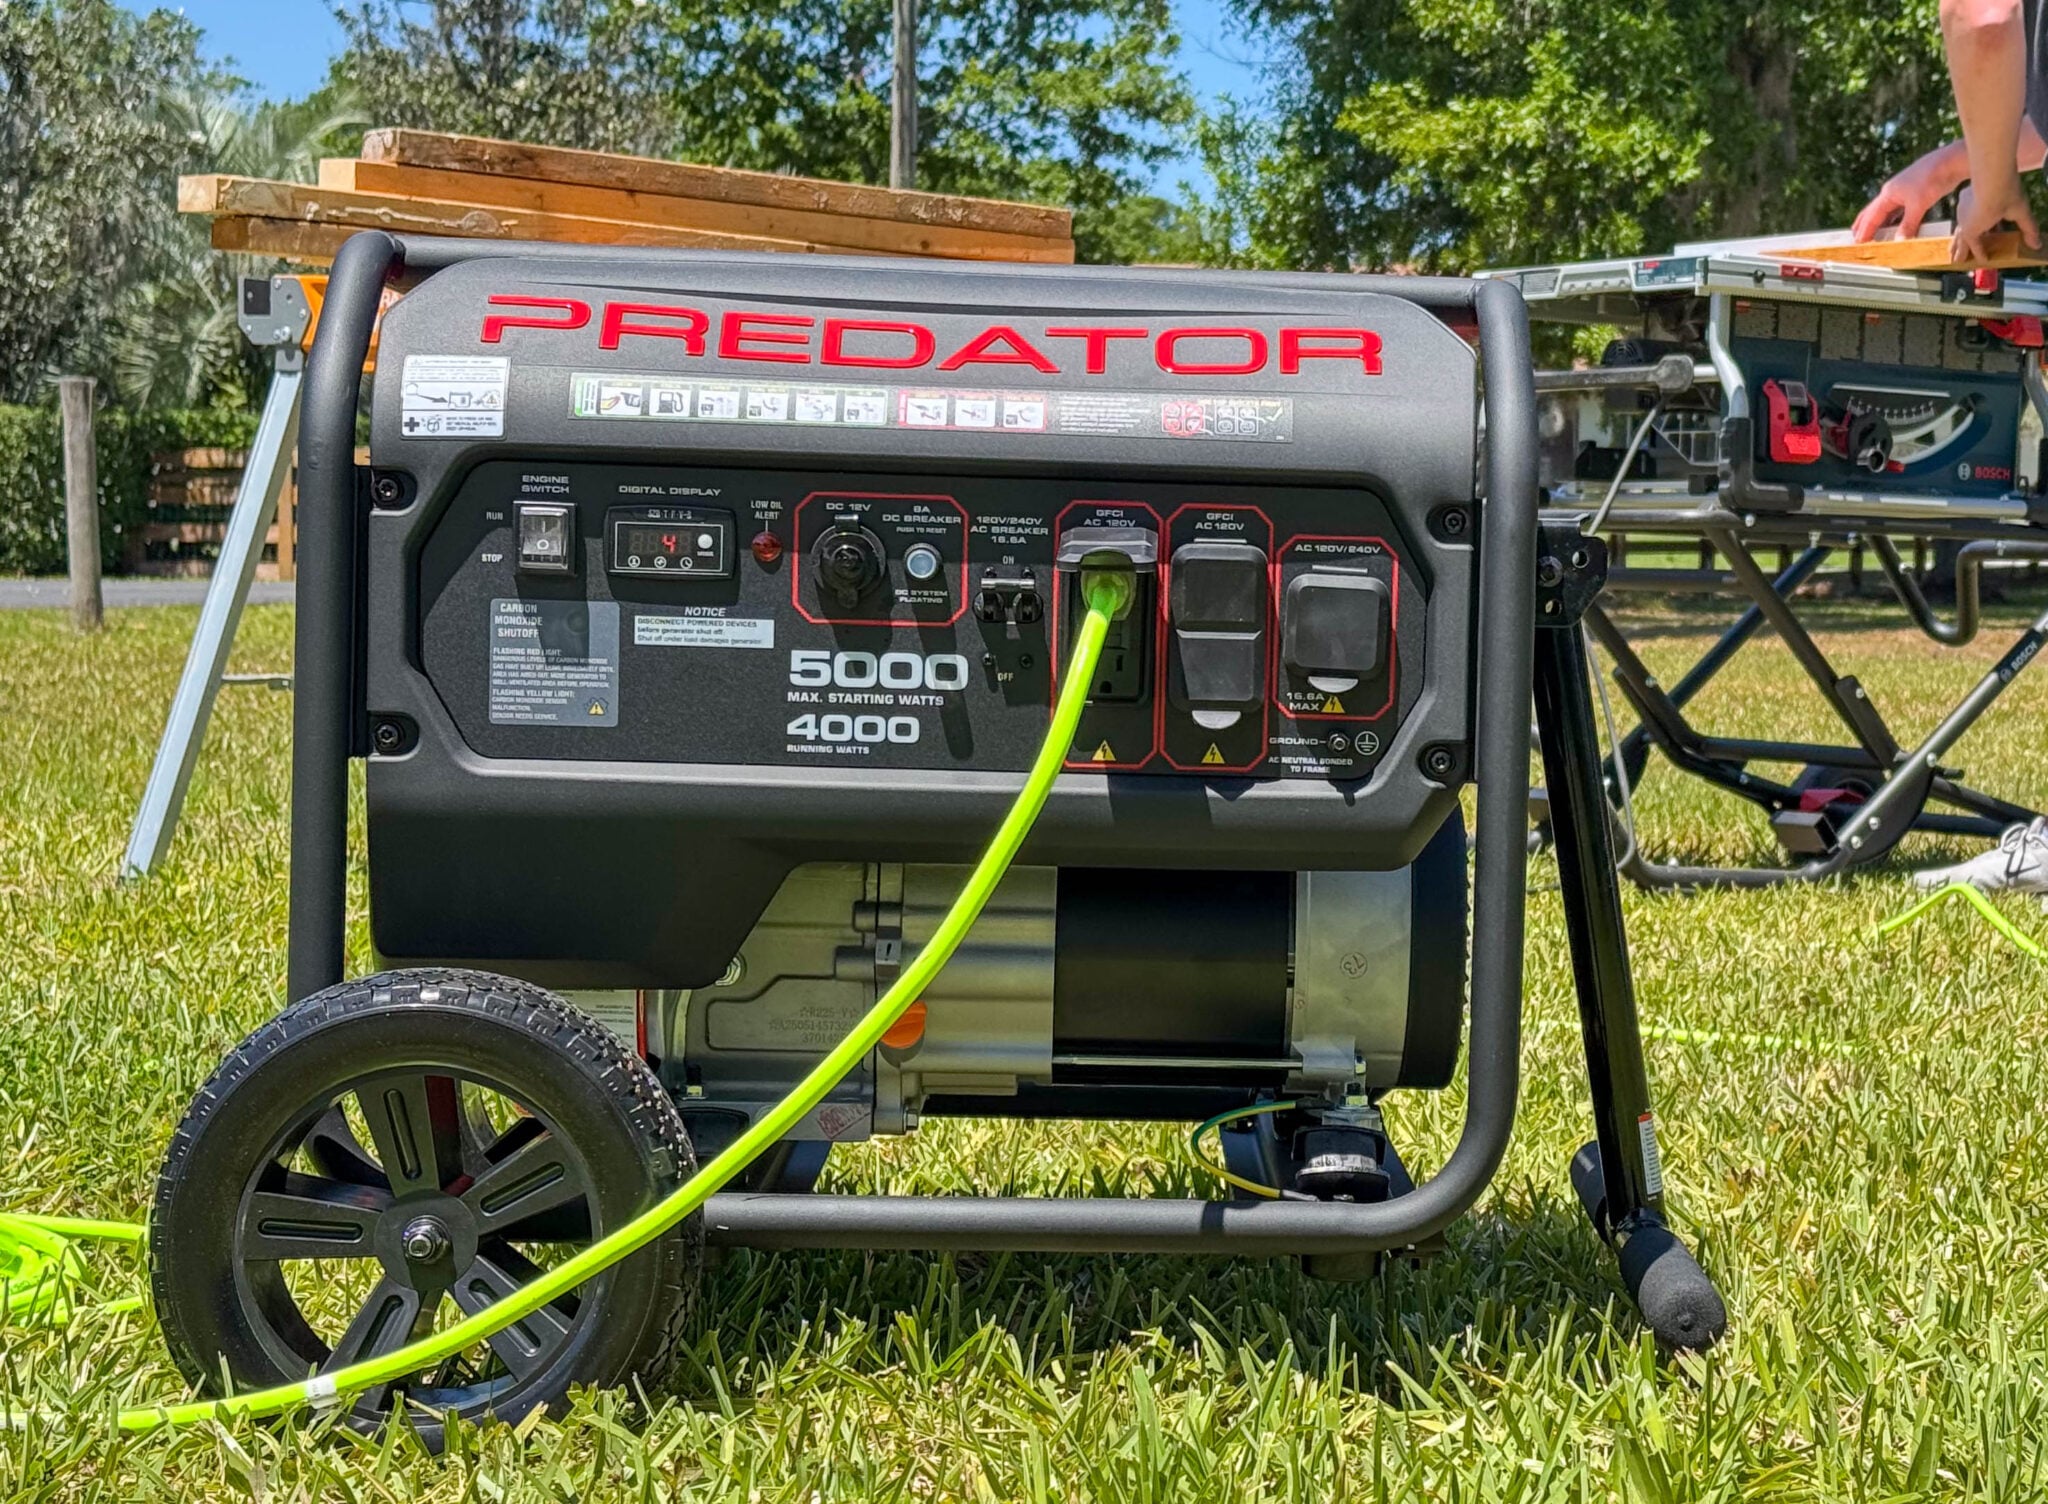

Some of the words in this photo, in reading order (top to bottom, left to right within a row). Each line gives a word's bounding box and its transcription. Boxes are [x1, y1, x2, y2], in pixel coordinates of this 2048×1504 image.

[480, 294, 1383, 376] PREDATOR
[1974, 465, 2011, 481] BOSCH
[522, 475, 569, 484] ENGINE
[521, 484, 570, 493] SWITCH
[618, 485, 667, 495] DIGITAL
[669, 487, 722, 497] DISPLAY
[750, 500, 769, 509] LOW
[770, 501, 783, 510] OIL
[826, 502, 844, 511] DC
[848, 503, 871, 512] 12V
[486, 511, 504, 521] RUN
[754, 511, 779, 520] ALERT
[882, 513, 900, 522] DC
[903, 515, 962, 524] BREAKER
[1096, 509, 1124, 518] GFCI
[1206, 512, 1234, 521] GFCI
[976, 516, 1043, 525] 120V/240V
[1083, 518, 1102, 526] AC
[1105, 519, 1136, 527] 120V
[925, 527, 948, 535] RESET
[970, 525, 988, 533] AC
[991, 526, 1049, 535] BREAKER
[1194, 522, 1213, 530] AC
[1214, 523, 1245, 531] 120V
[1294, 544, 1313, 552] AC
[481, 553, 503, 563] STOP
[1002, 555, 1015, 565] ON
[899, 596, 943, 604] FLOATING
[500, 603, 538, 613] CARBON
[684, 606, 727, 617] NOTICE
[494, 615, 543, 626] MONOXIDE
[637, 617, 685, 626] DISCONNECT
[686, 619, 723, 627] POWERED
[725, 620, 758, 628] DEVICES
[497, 628, 539, 638] SHUTOFF
[661, 627, 695, 635] generator
[2010, 641, 2038, 671] BOSCH
[789, 650, 969, 691] 5000
[997, 671, 1014, 682] OFF
[492, 688, 524, 697] FLASHING
[526, 689, 554, 698] YELLOW
[787, 692, 823, 703] MAX.
[828, 693, 894, 705] STARTING
[899, 695, 944, 706] WATTS
[1289, 702, 1319, 711] MAX
[787, 713, 920, 744] 4000
[1269, 737, 1319, 745] GROUND
[787, 744, 833, 754] RUNNING
[836, 745, 870, 755] WATTS
[1281, 757, 1318, 765] NEUTRAL
[1319, 758, 1353, 766] BONDED
[1290, 765, 1300, 773] TO
